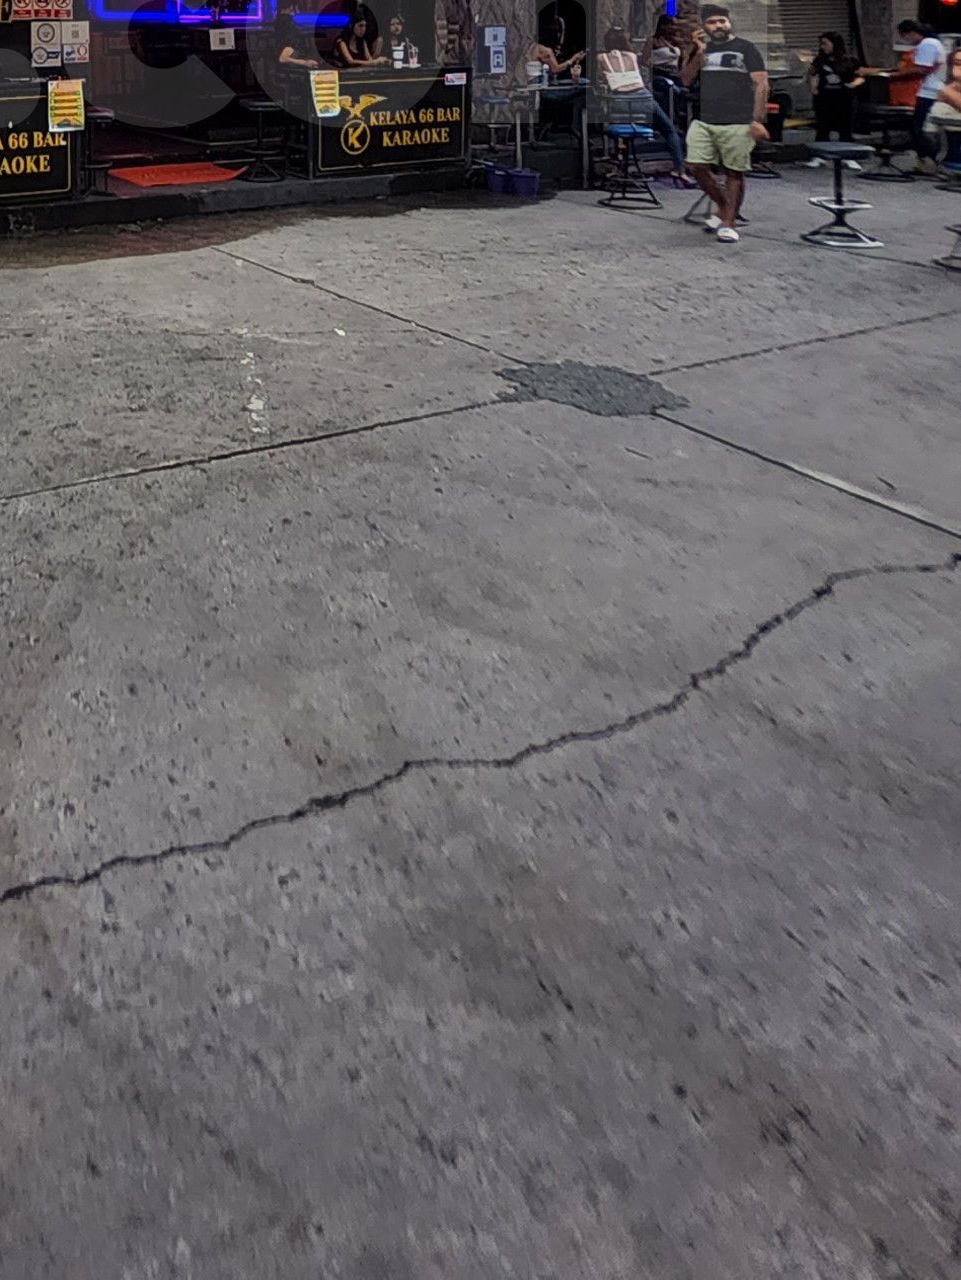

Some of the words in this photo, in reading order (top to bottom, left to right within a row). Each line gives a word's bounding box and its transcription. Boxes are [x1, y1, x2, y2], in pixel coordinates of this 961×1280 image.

[369, 109, 416, 127] KELAYA
[418, 108, 434, 123] 66
[437, 107, 461, 122] BAR
[8, 131, 29, 150] 66
[382, 127, 450, 148] KARAOKE
